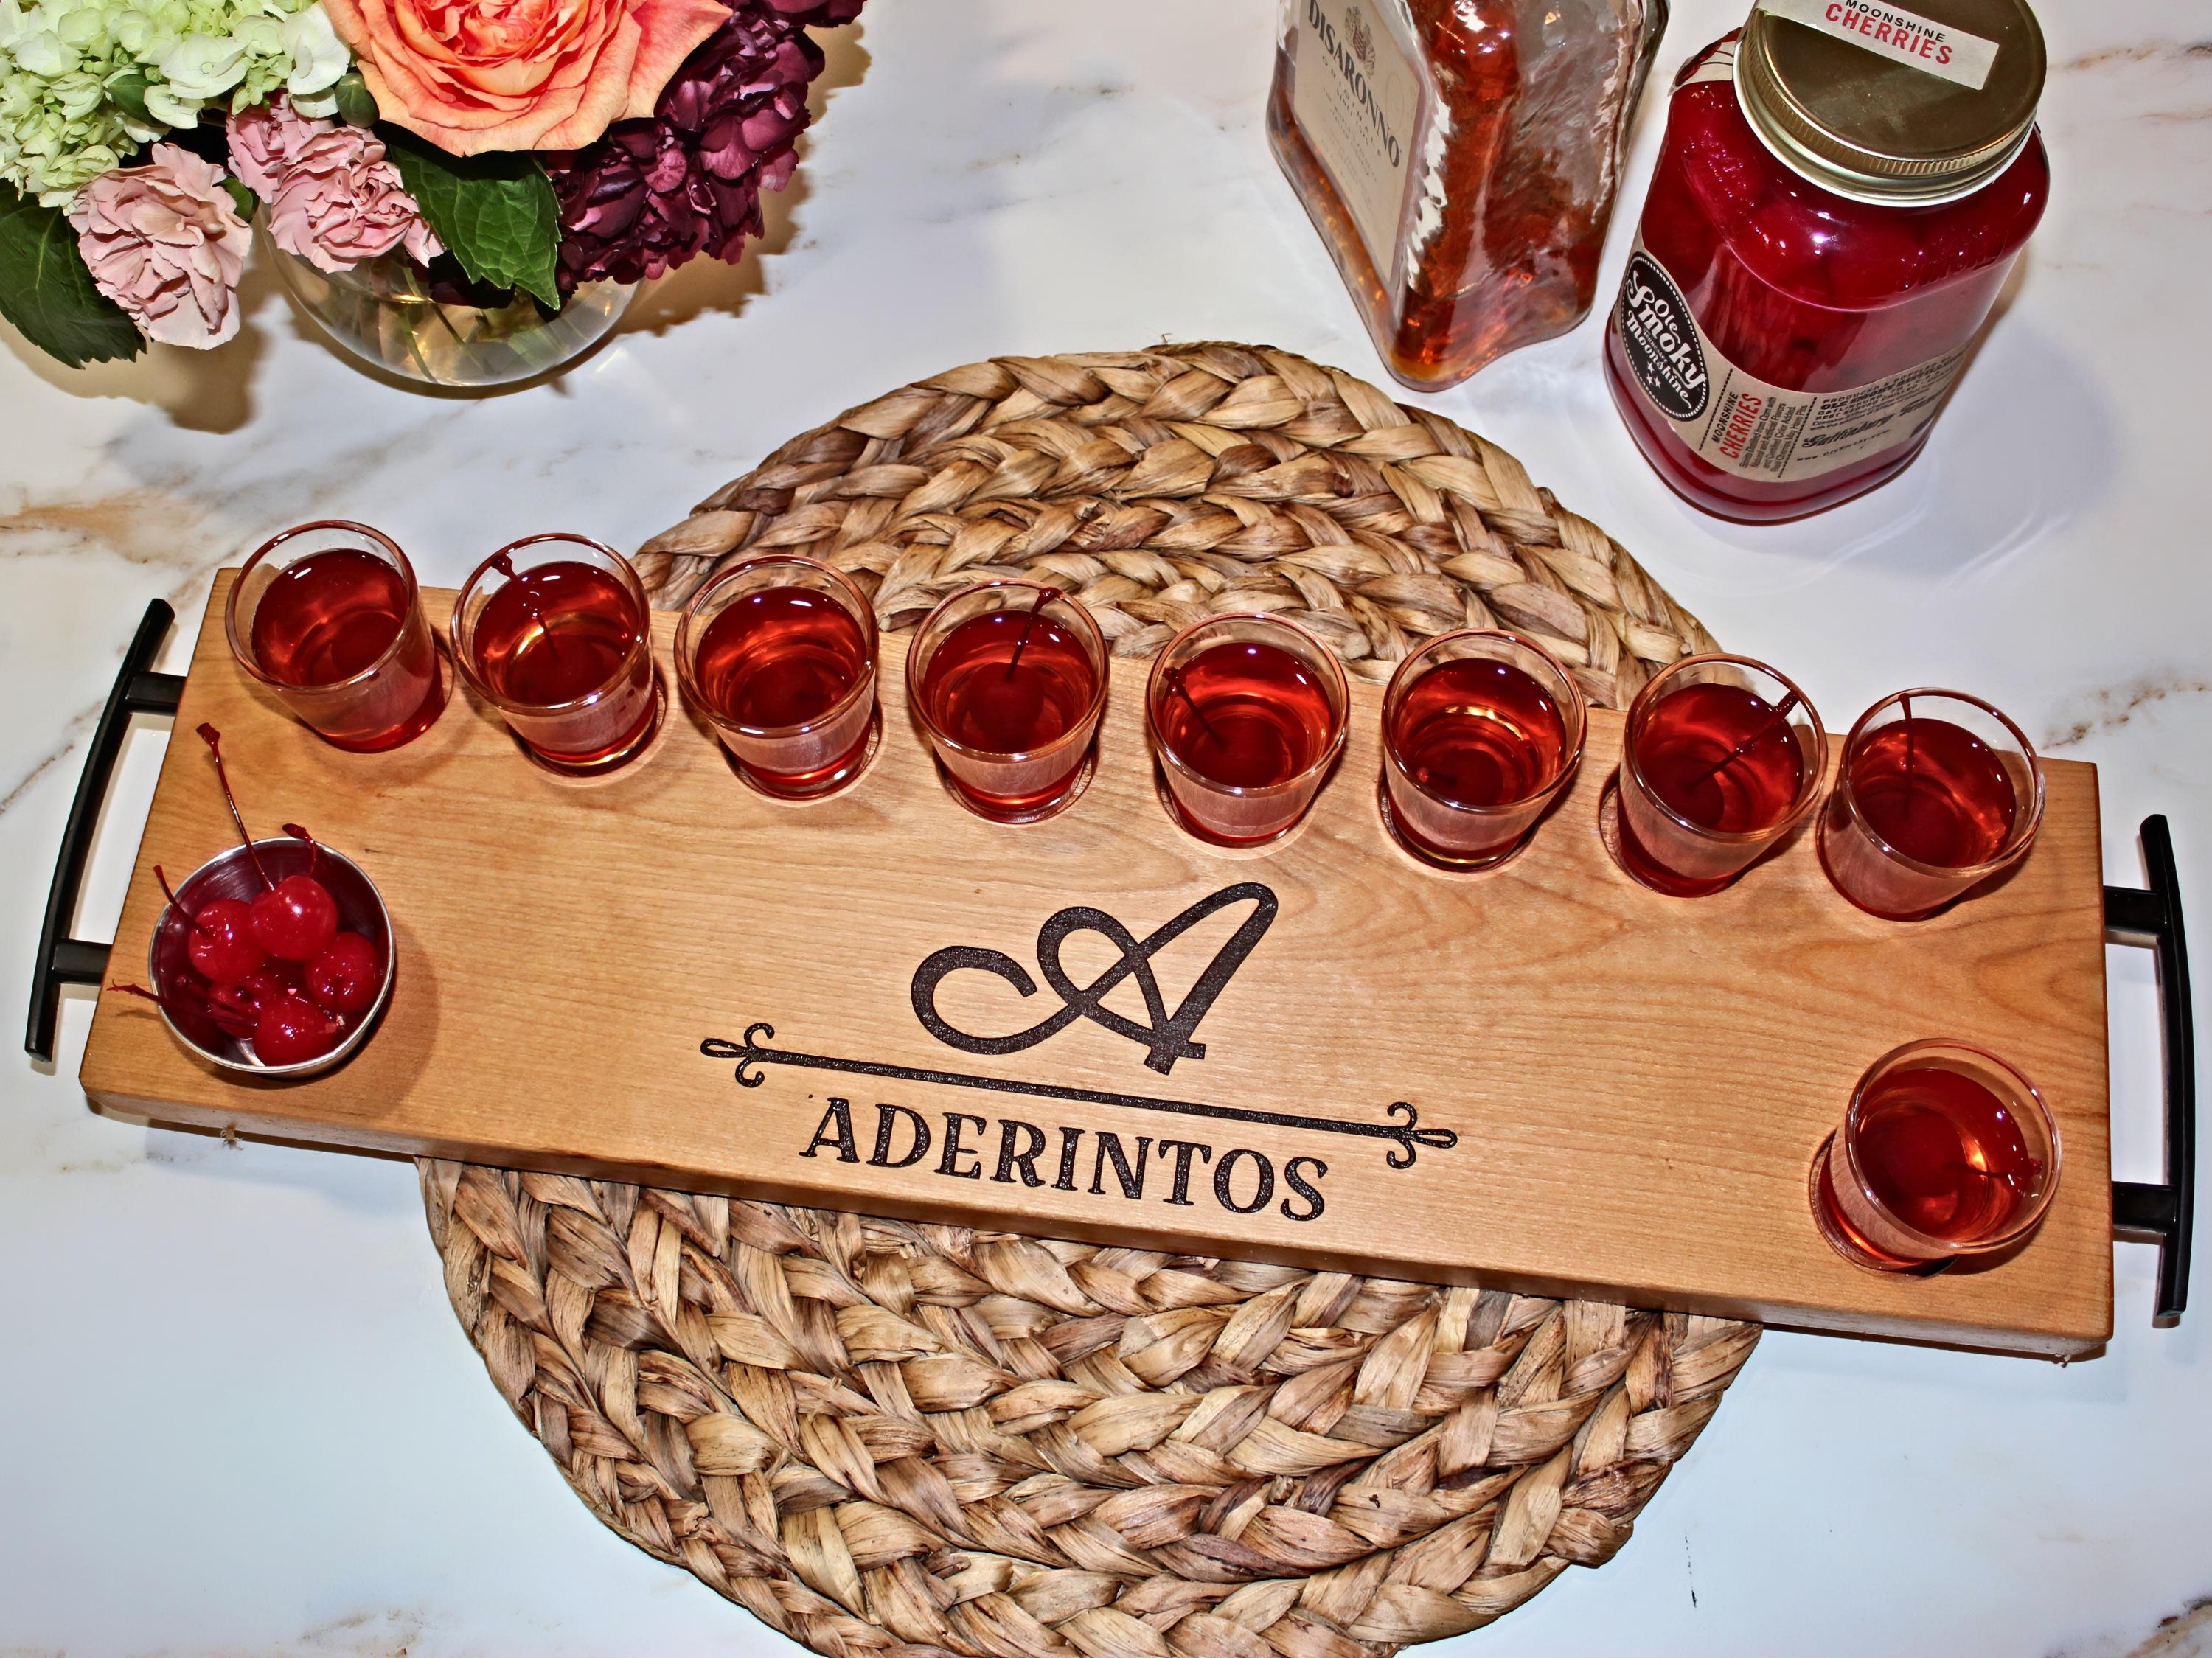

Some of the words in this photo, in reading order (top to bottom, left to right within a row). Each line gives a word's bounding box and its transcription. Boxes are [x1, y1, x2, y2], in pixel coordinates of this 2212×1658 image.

[1825, 3, 1952, 65] CHERRIES
[1845, 0, 1946, 42] MOONSHINE
[1308, 0, 1400, 167] DISARONNO
[1627, 270, 1707, 389] Smoky
[1655, 299, 1681, 344] Ole
[1711, 391, 1739, 443] MOONSHINE
[1719, 393, 1762, 459] CHERRIES
[911, 882, 1279, 1075] A
[799, 1097, 1328, 1221] ADERINTOS
